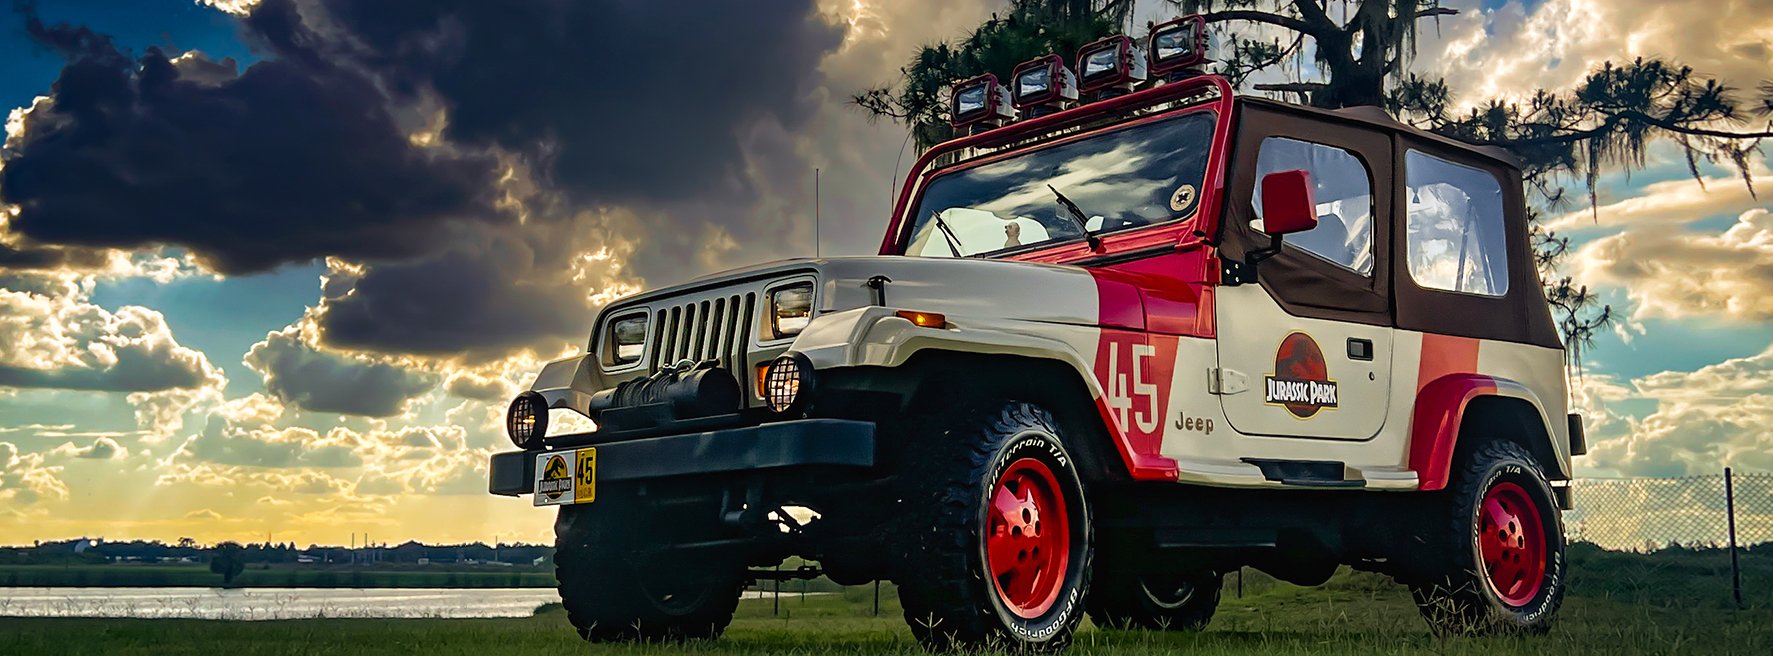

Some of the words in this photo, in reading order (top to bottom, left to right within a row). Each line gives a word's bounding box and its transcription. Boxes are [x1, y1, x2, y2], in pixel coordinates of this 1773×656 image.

[1107, 341, 1159, 434] 45
[1266, 378, 1310, 402] JURASSIC
[1309, 380, 1337, 405] PARK
[1175, 411, 1214, 435] Jeep
[1049, 443, 1067, 467] T/A
[577, 456, 594, 486] 45
[1011, 587, 1078, 639] BFGoodrich
